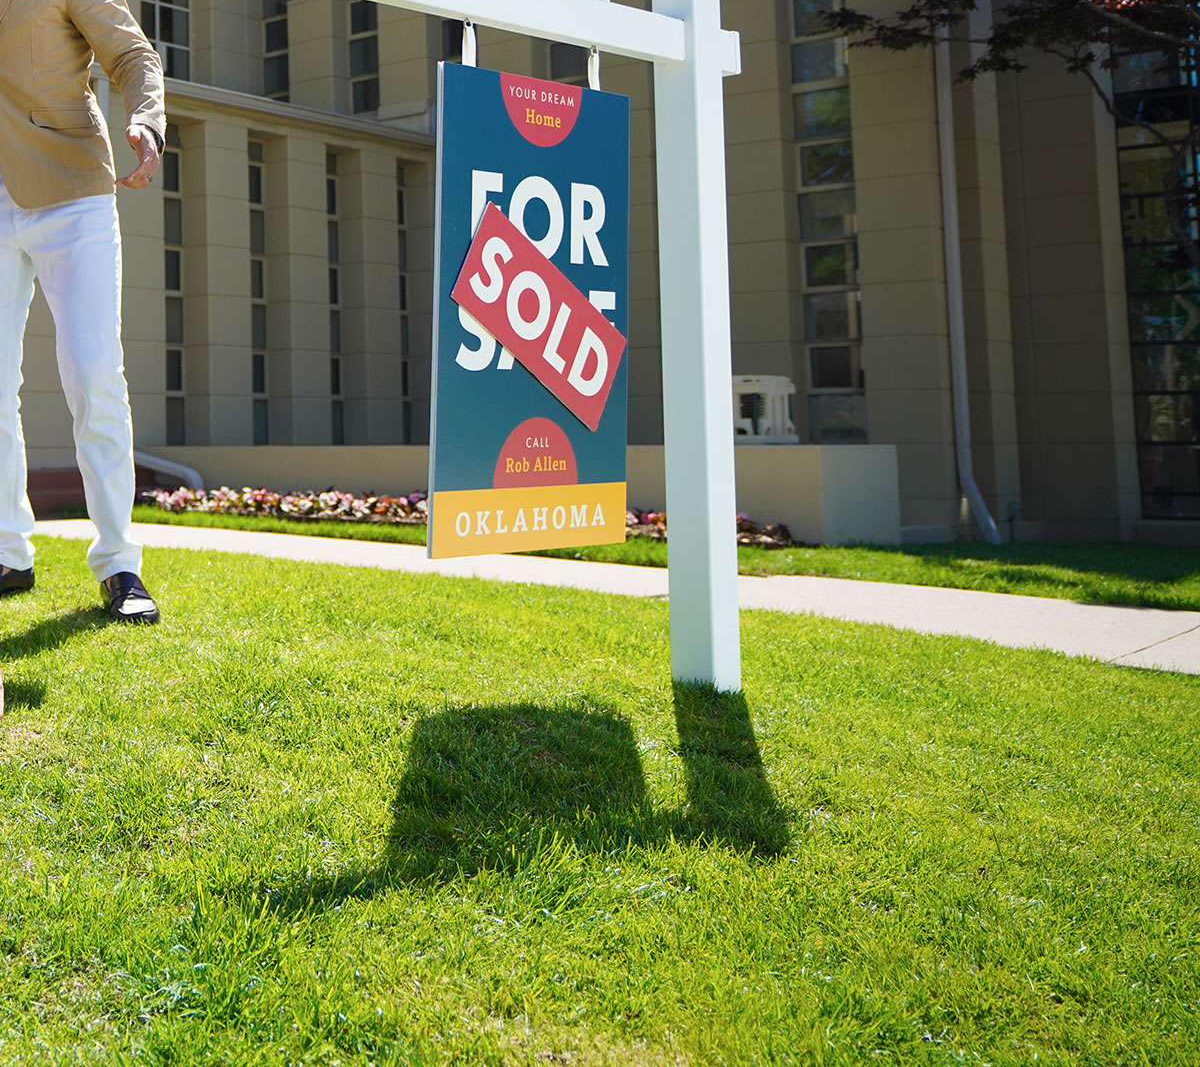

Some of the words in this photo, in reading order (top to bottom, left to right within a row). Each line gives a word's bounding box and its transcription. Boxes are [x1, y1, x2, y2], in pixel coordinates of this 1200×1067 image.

[509, 86, 537, 101] YOUR
[541, 92, 575, 107] DREAM
[525, 108, 562, 128] Home
[471, 170, 610, 267] FOR
[469, 236, 609, 397] SOLD
[525, 437, 550, 448] CALL
[505, 457, 530, 473] Rob
[533, 456, 567, 472] Allen
[455, 503, 606, 537] OKLAHOMA
